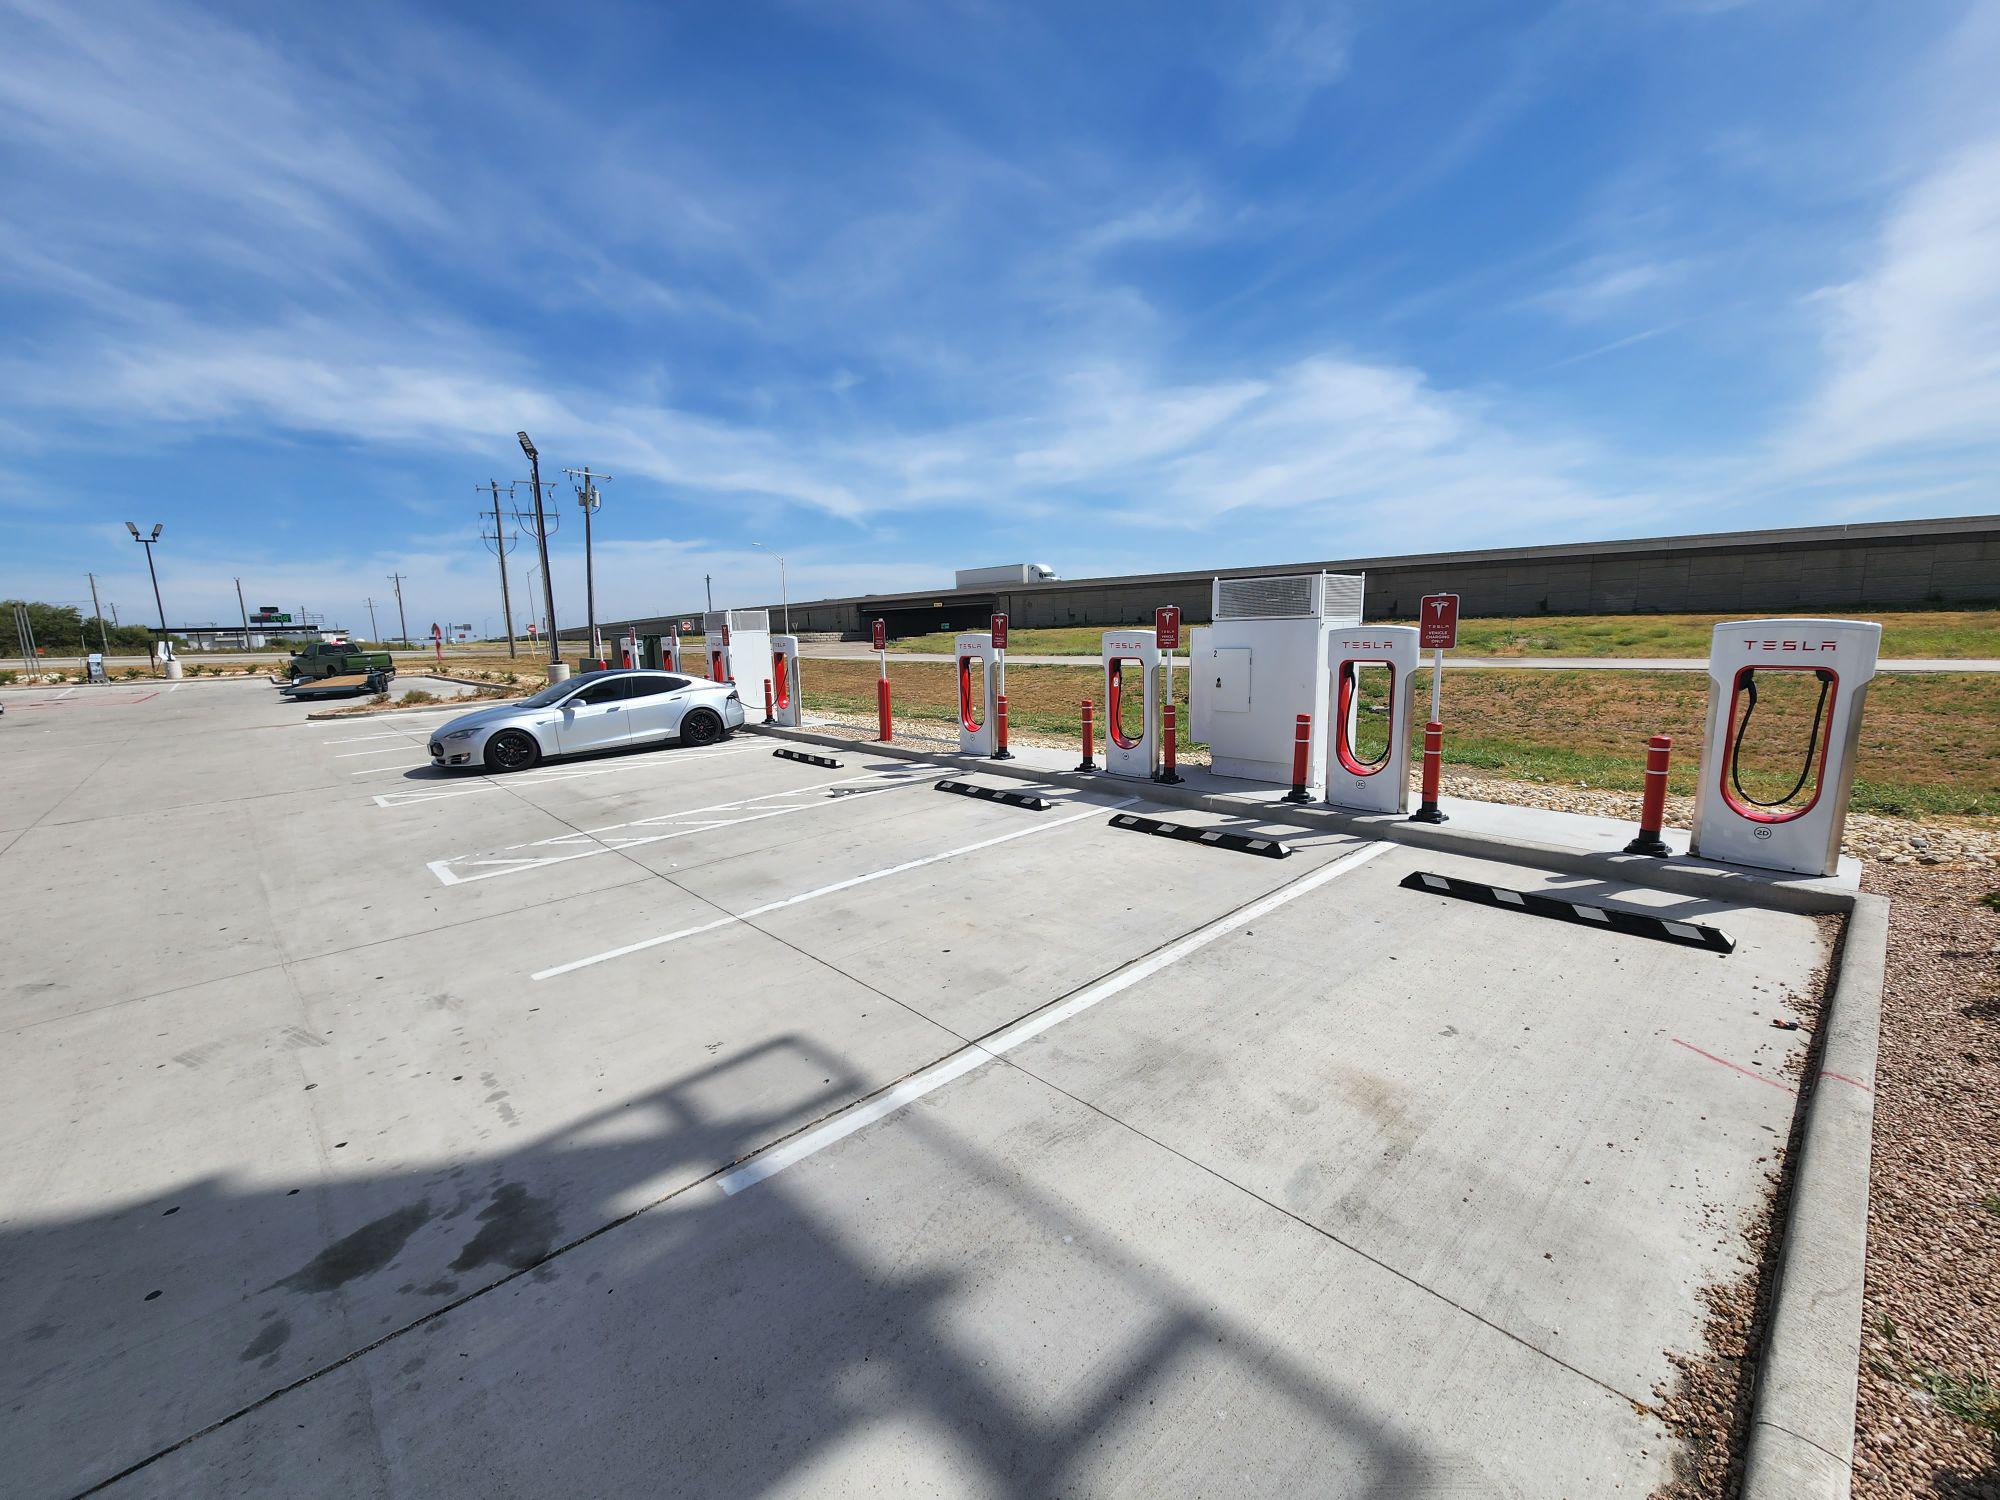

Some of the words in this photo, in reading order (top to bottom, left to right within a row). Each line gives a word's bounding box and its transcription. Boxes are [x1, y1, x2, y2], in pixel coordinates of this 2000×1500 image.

[1342, 641, 1393, 649] TESLA
[1743, 640, 1837, 651] TESLA
[1213, 649, 1218, 658] 2
